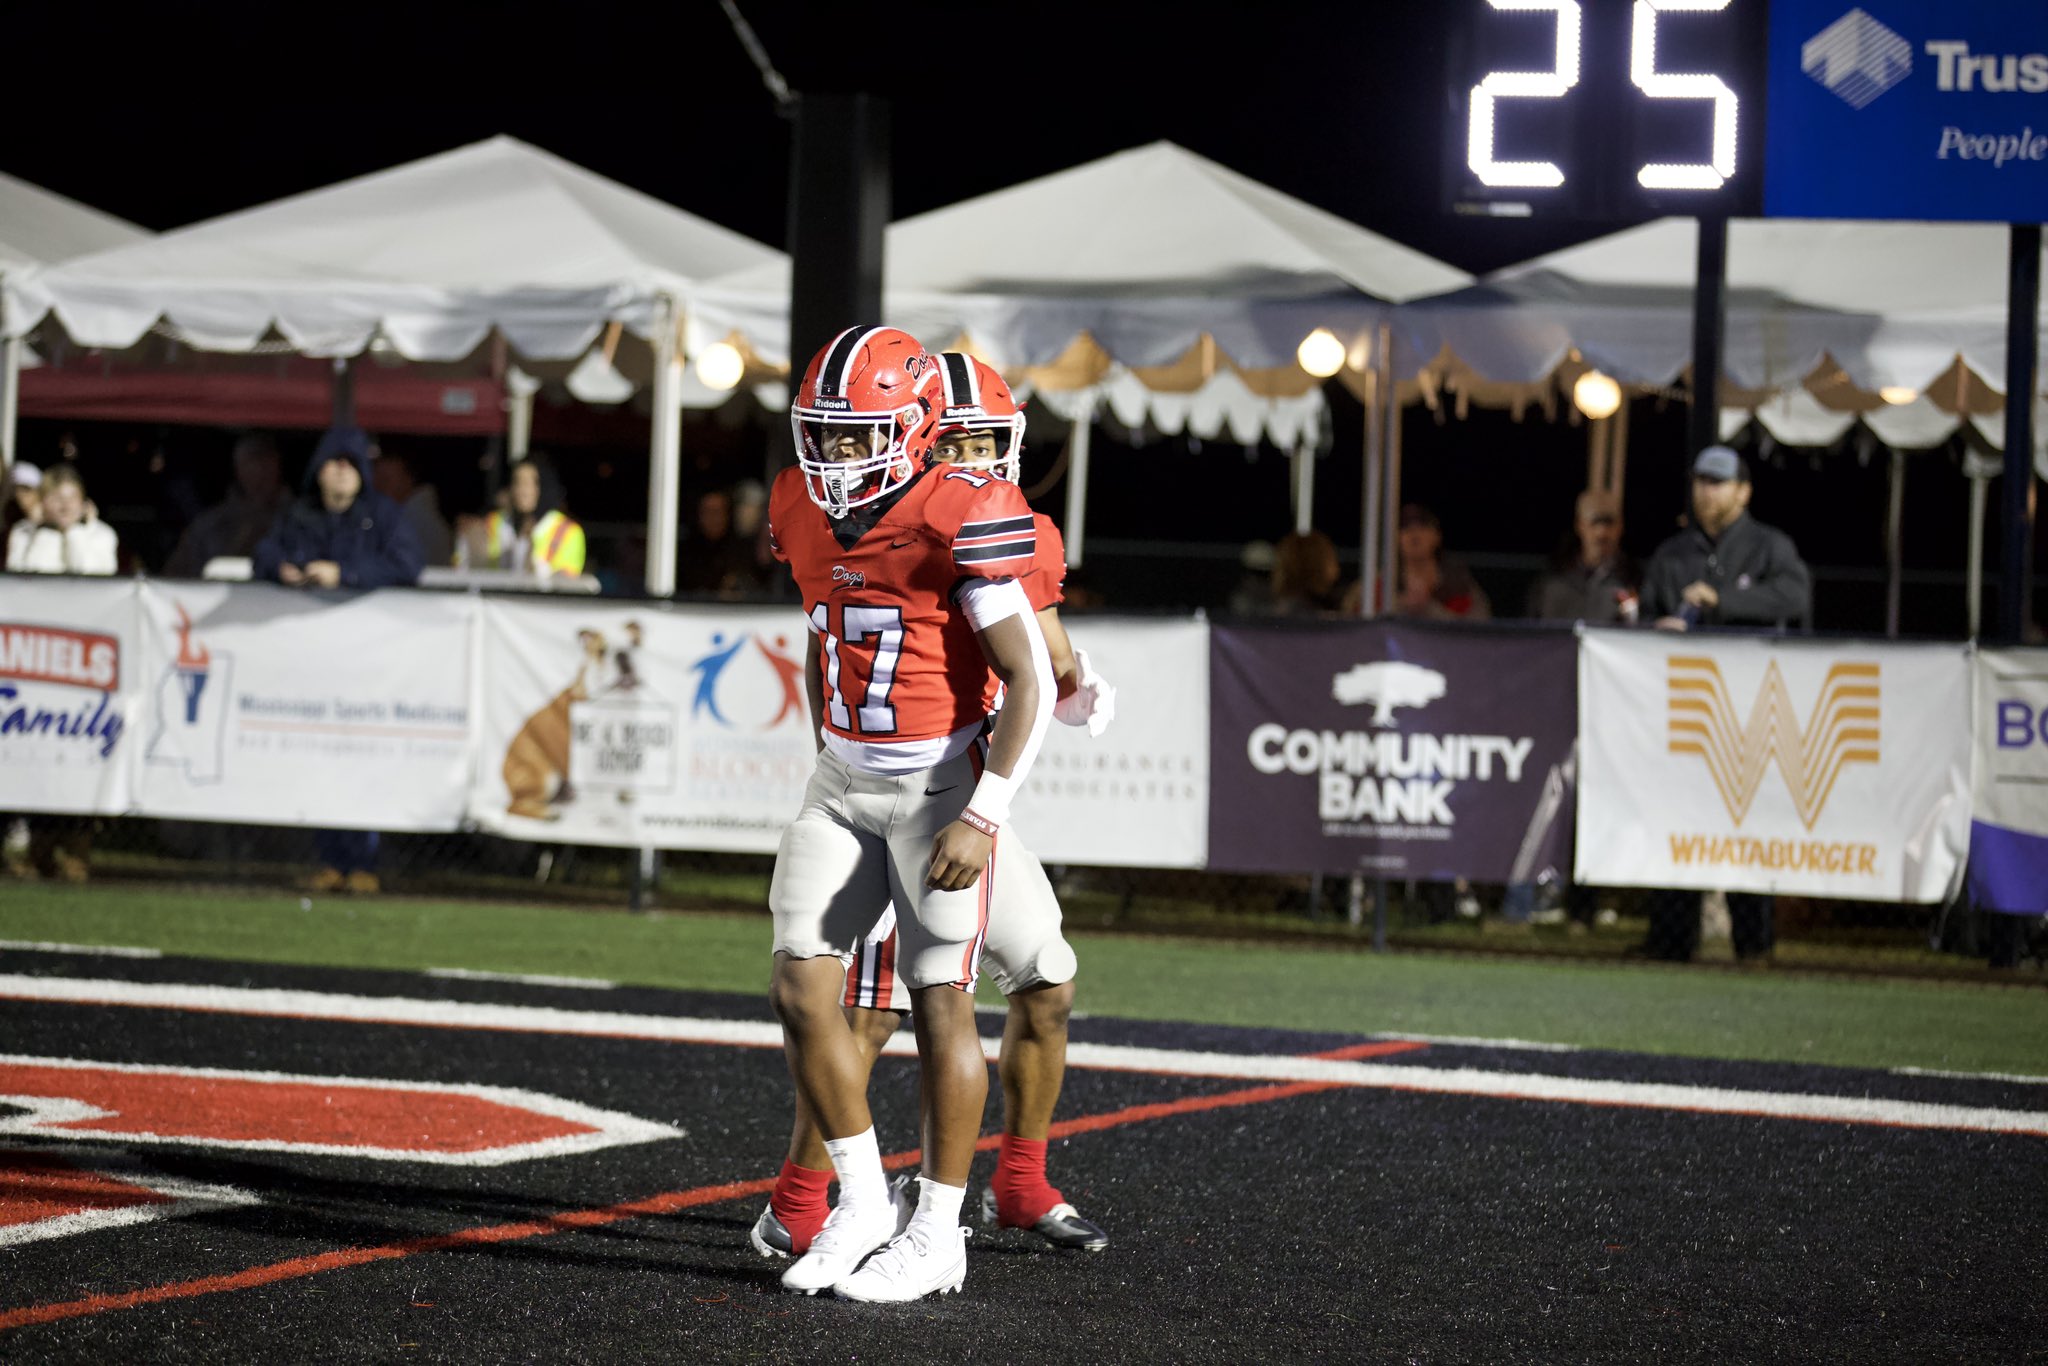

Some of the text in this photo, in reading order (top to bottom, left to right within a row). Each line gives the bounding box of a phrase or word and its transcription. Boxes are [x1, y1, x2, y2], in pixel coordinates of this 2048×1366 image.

[1468, 0, 1738, 189] 25
[814, 398, 847, 409] Riddell
[832, 565, 864, 586] Dogs
[810, 601, 905, 735] 17
[1996, 700, 2048, 749] B
[1247, 723, 1534, 783] COMMUNITY
[1318, 772, 1456, 825] BANK
[1668, 833, 1878, 875] WHATABURGER
